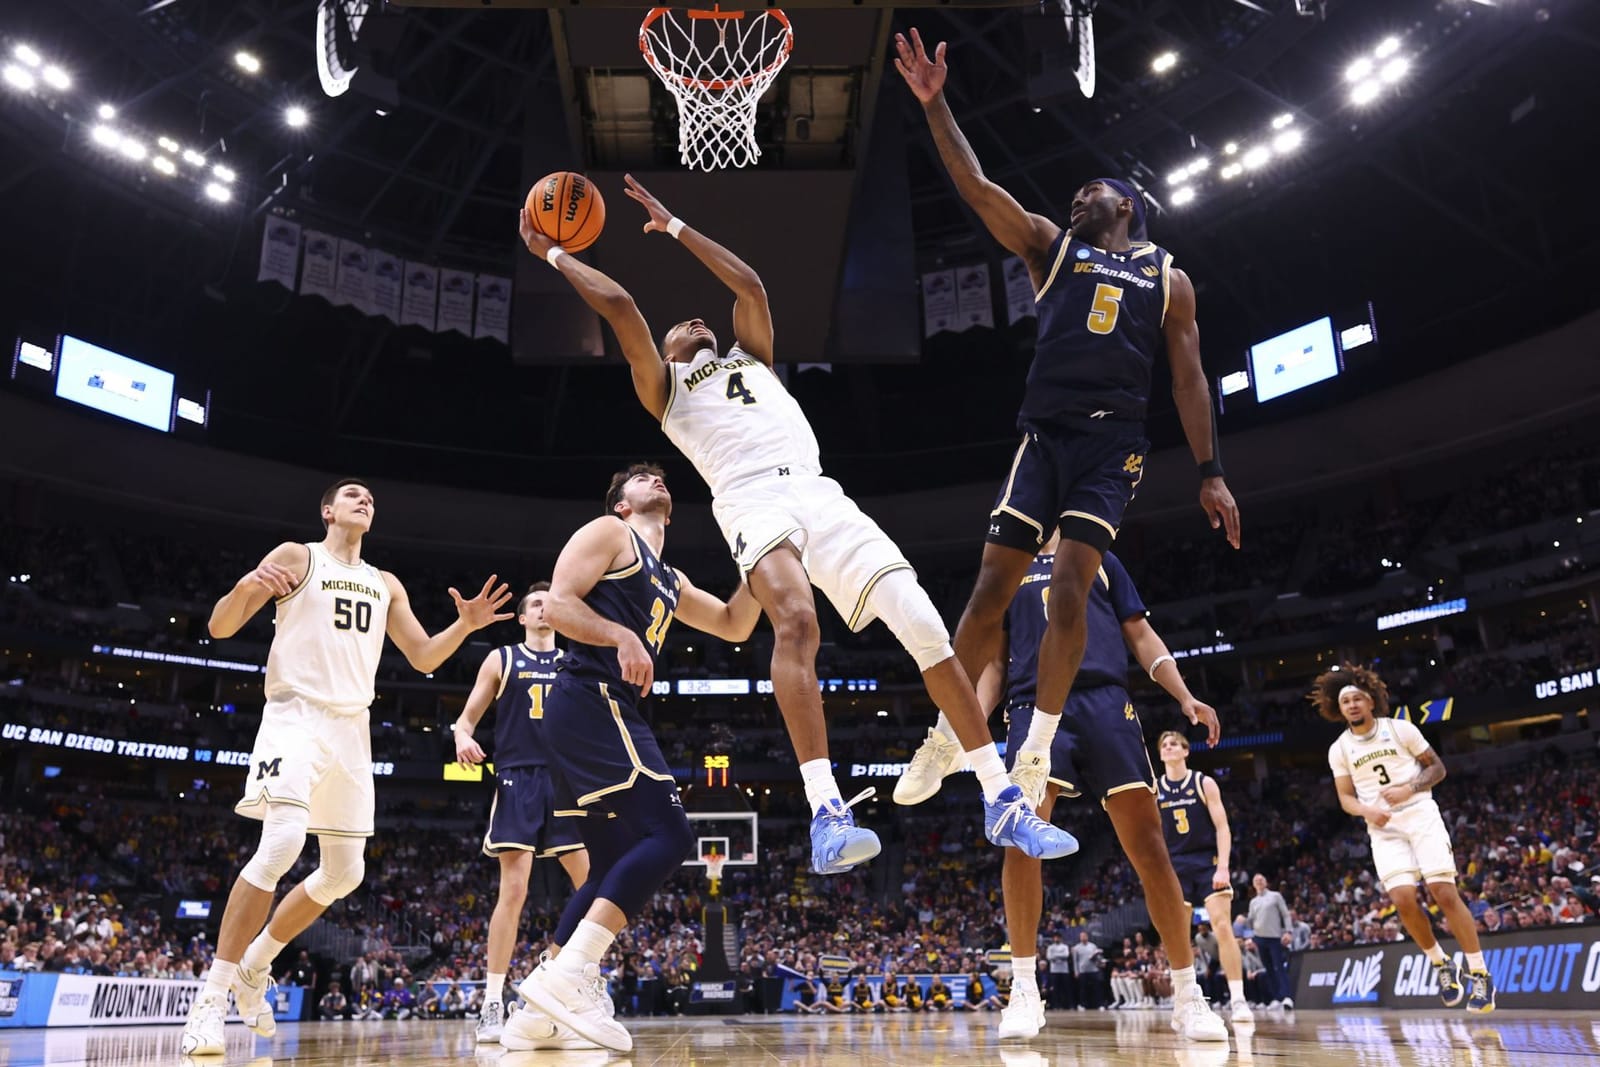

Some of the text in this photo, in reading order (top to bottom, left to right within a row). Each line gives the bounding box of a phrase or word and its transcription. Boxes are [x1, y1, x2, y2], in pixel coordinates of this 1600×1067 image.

[565, 175, 586, 221] Wilson
[1087, 283, 1124, 335] 5
[726, 372, 757, 405] 4
[778, 467, 791, 476] M
[321, 580, 381, 601] MICHIGAN
[334, 597, 372, 634] 50
[165, 654, 206, 667] BASKETBALL
[207, 659, 259, 672] CHAMPIONSHIP
[652, 681, 670, 695] 60
[1535, 680, 1558, 699] UC
[1560, 671, 1594, 693] SAN
[2, 723, 27, 741] UC
[28, 728, 63, 746] SAN
[64, 733, 114, 753] DIEGO
[117, 741, 189, 761] TRITONS
[194, 749, 212, 762] VS
[257, 757, 283, 782] M
[867, 763, 911, 777] FIRST
[1353, 748, 1398, 769] MICHIGAN
[1373, 764, 1391, 786] 3
[1173, 808, 1190, 835] 3
[1394, 954, 1440, 996] CALL
[90, 983, 165, 1018] MOUNTAIN
[165, 985, 198, 1017] WEST
